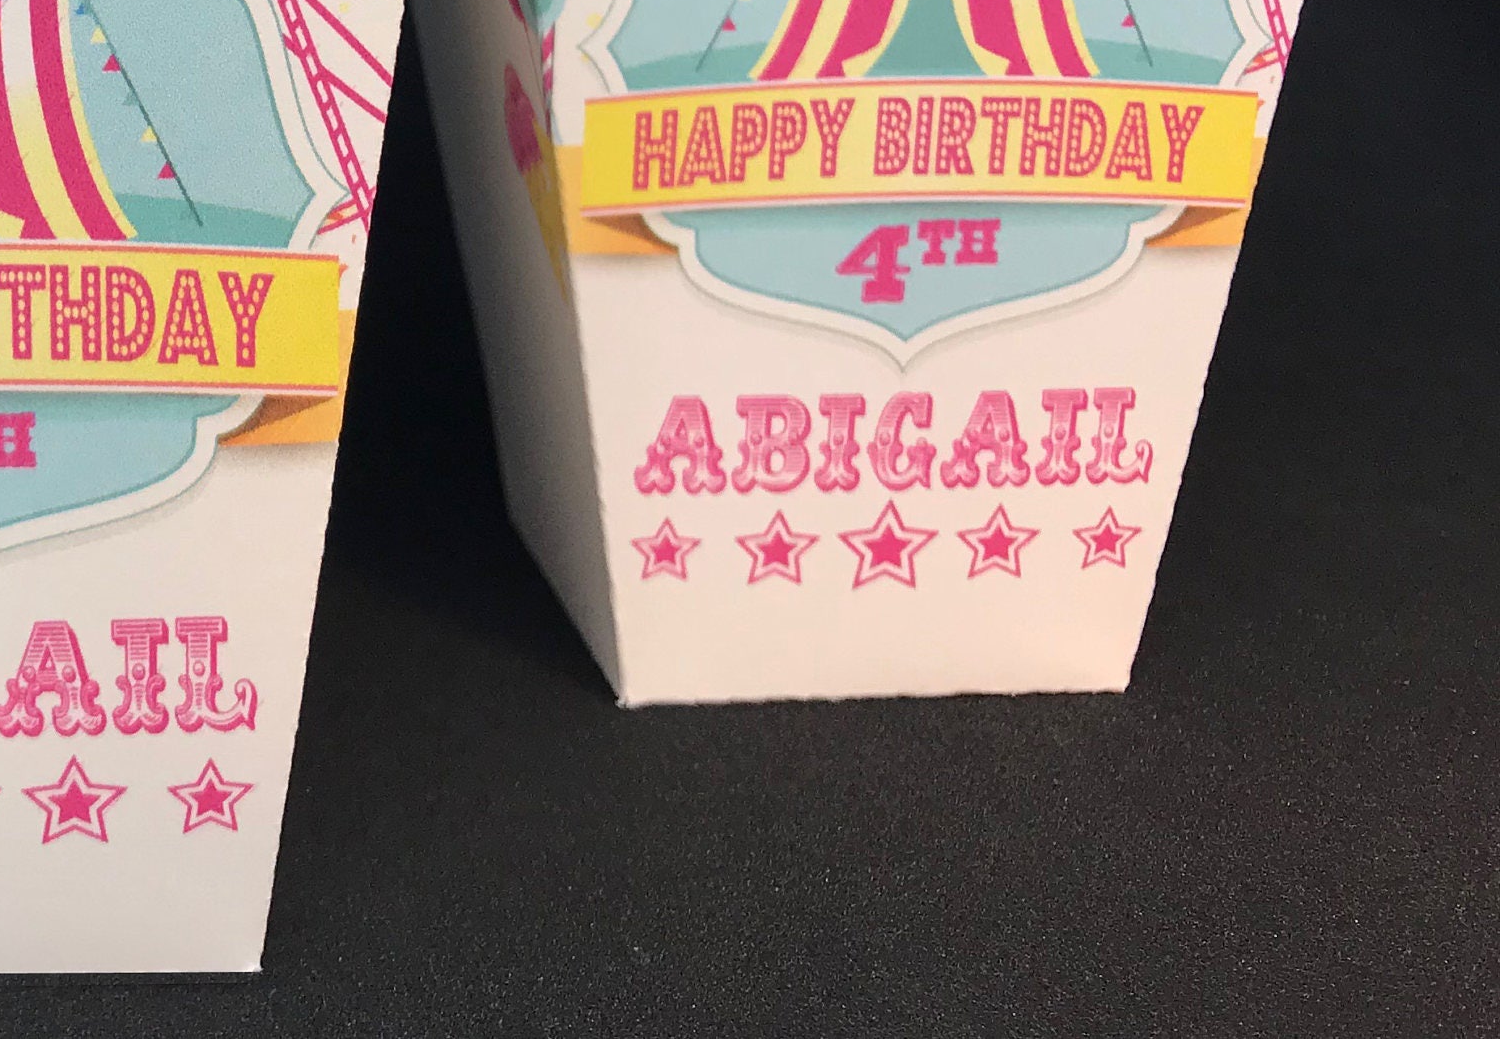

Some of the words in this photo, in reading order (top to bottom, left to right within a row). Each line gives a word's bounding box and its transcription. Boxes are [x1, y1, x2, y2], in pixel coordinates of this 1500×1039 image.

[632, 98, 856, 191] HAPPY
[874, 95, 1206, 184] BIRTHDAY
[835, 217, 1002, 303] 4TH
[633, 386, 1153, 496] ABIGAIL
